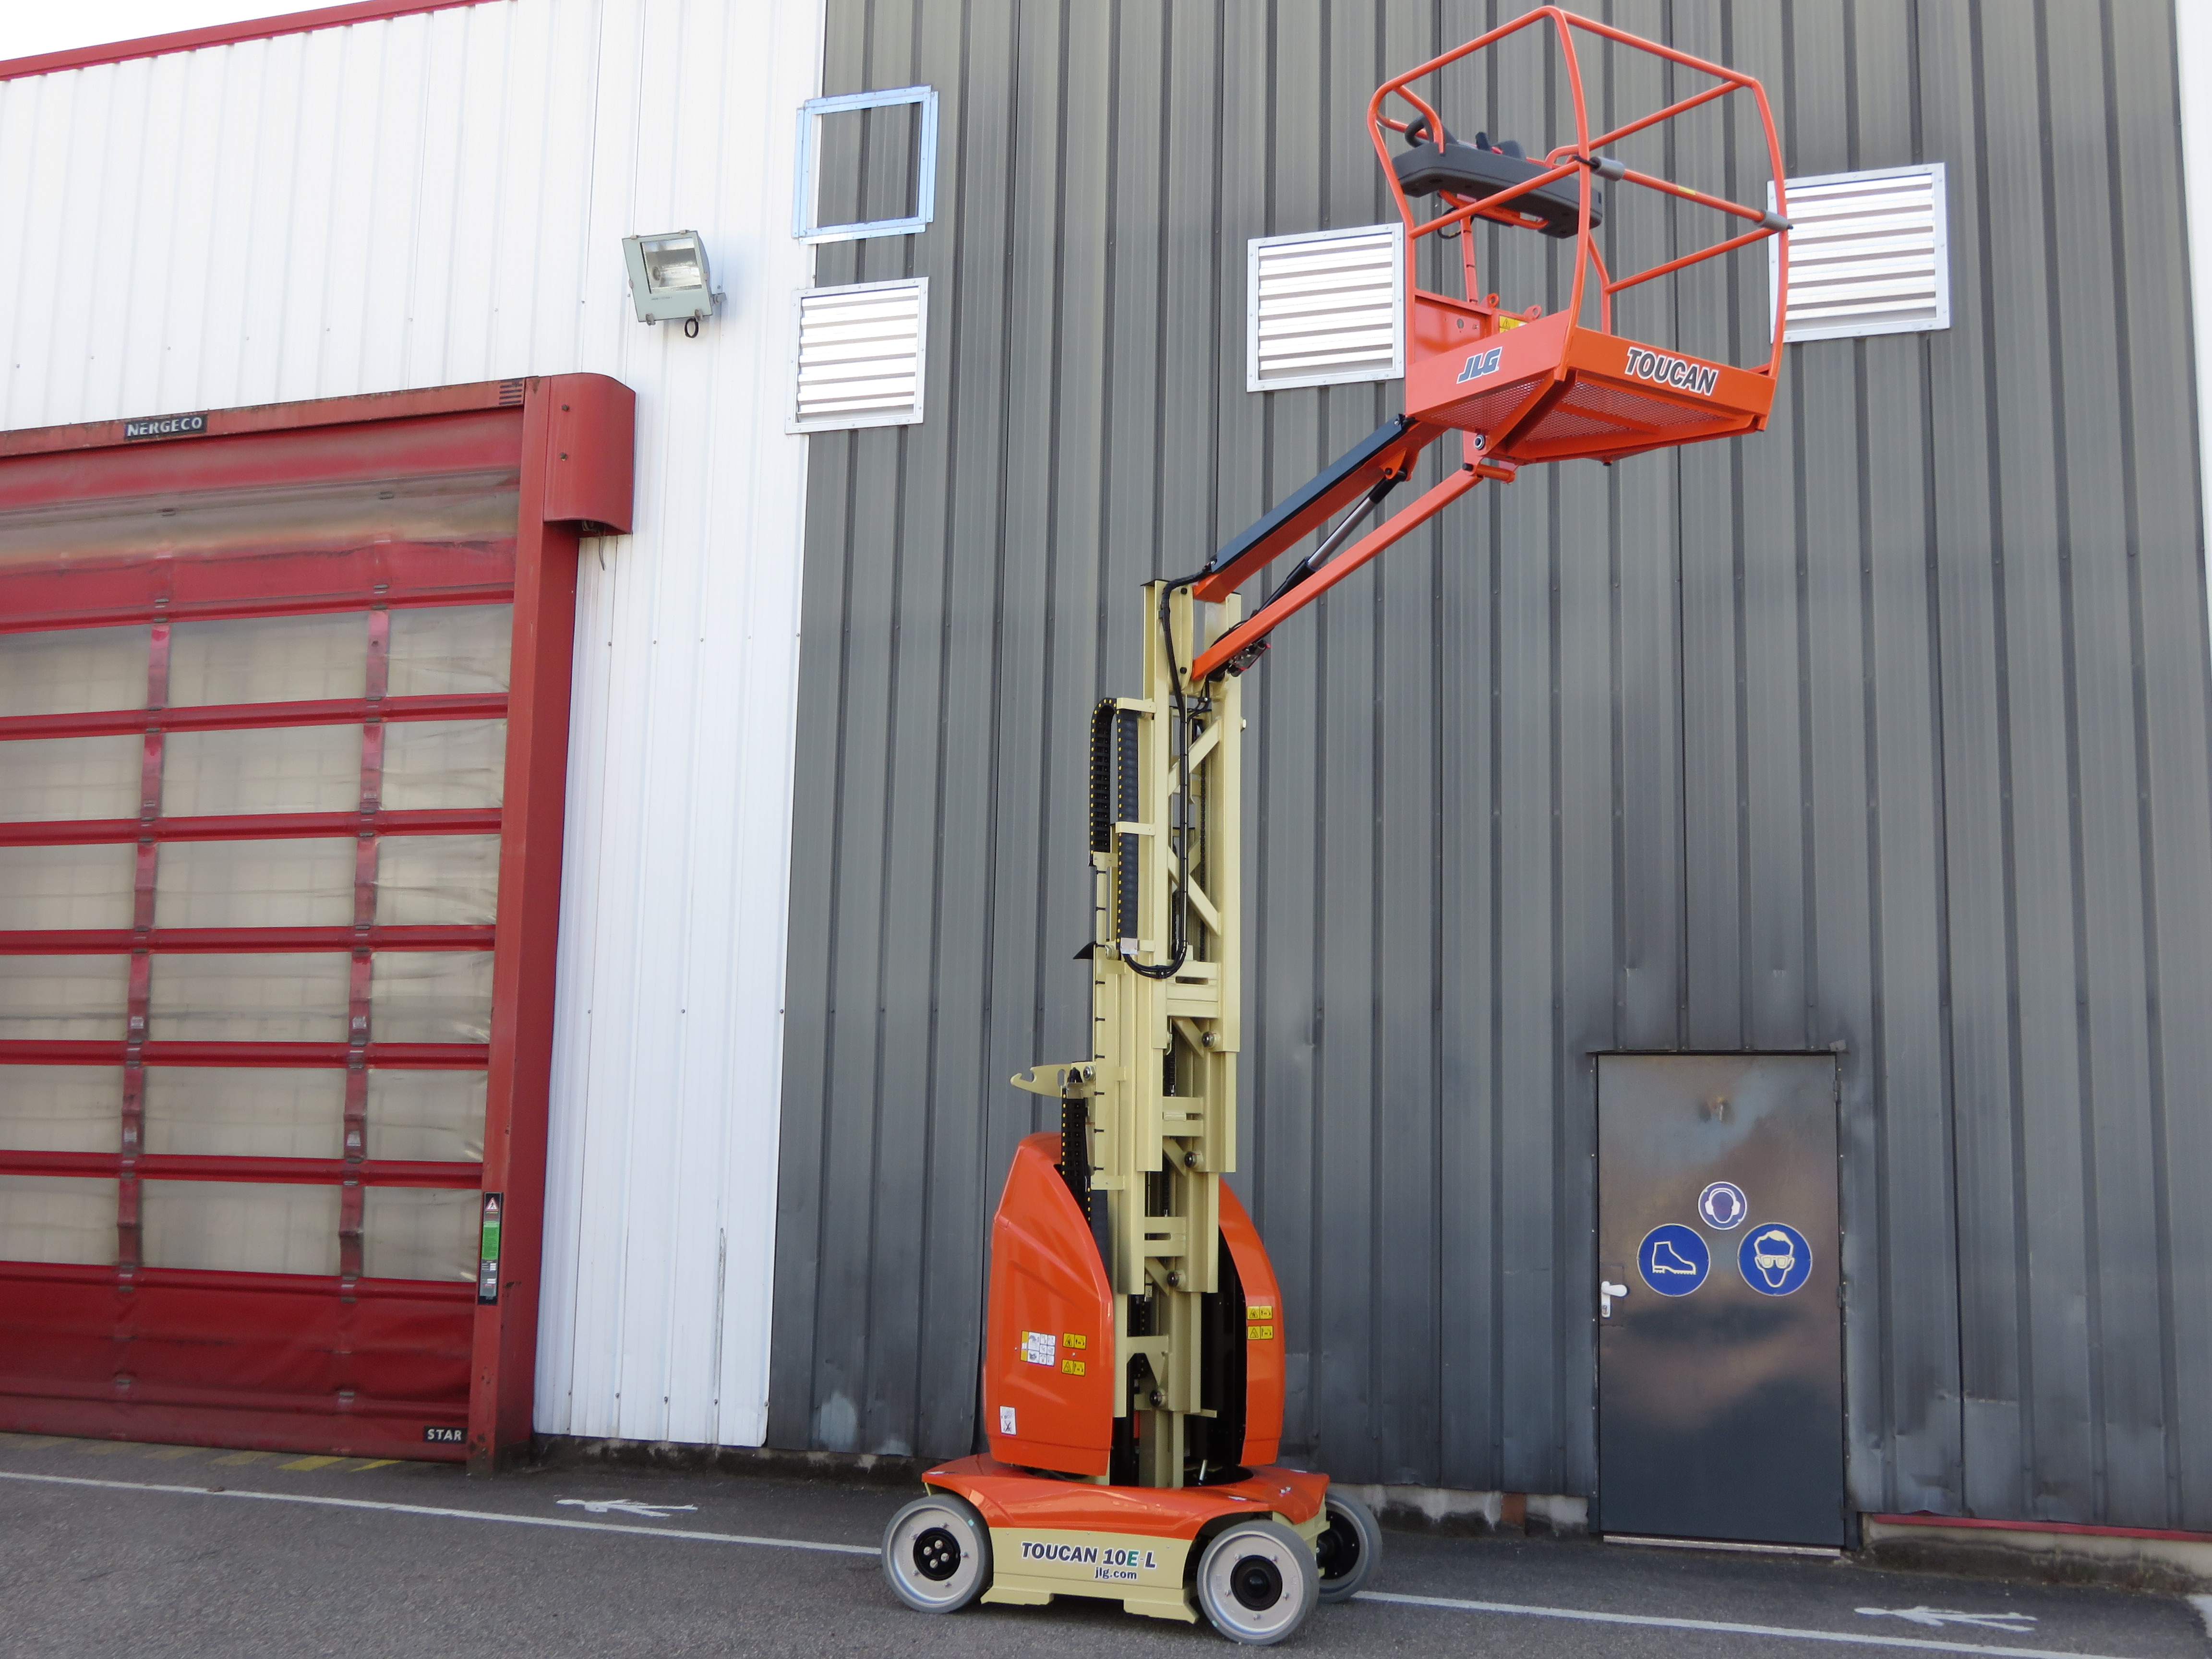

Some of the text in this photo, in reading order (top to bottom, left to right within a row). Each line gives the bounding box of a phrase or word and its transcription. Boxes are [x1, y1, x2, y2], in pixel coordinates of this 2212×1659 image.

[1456, 347, 1503, 383] JLG
[1625, 348, 1719, 395] TOUCAN
[127, 417, 202, 436] NERGECO
[427, 1429, 461, 1441] STAR
[1022, 1542, 1097, 1563] TOUCAN
[1094, 1567, 1137, 1580] jlg.com
